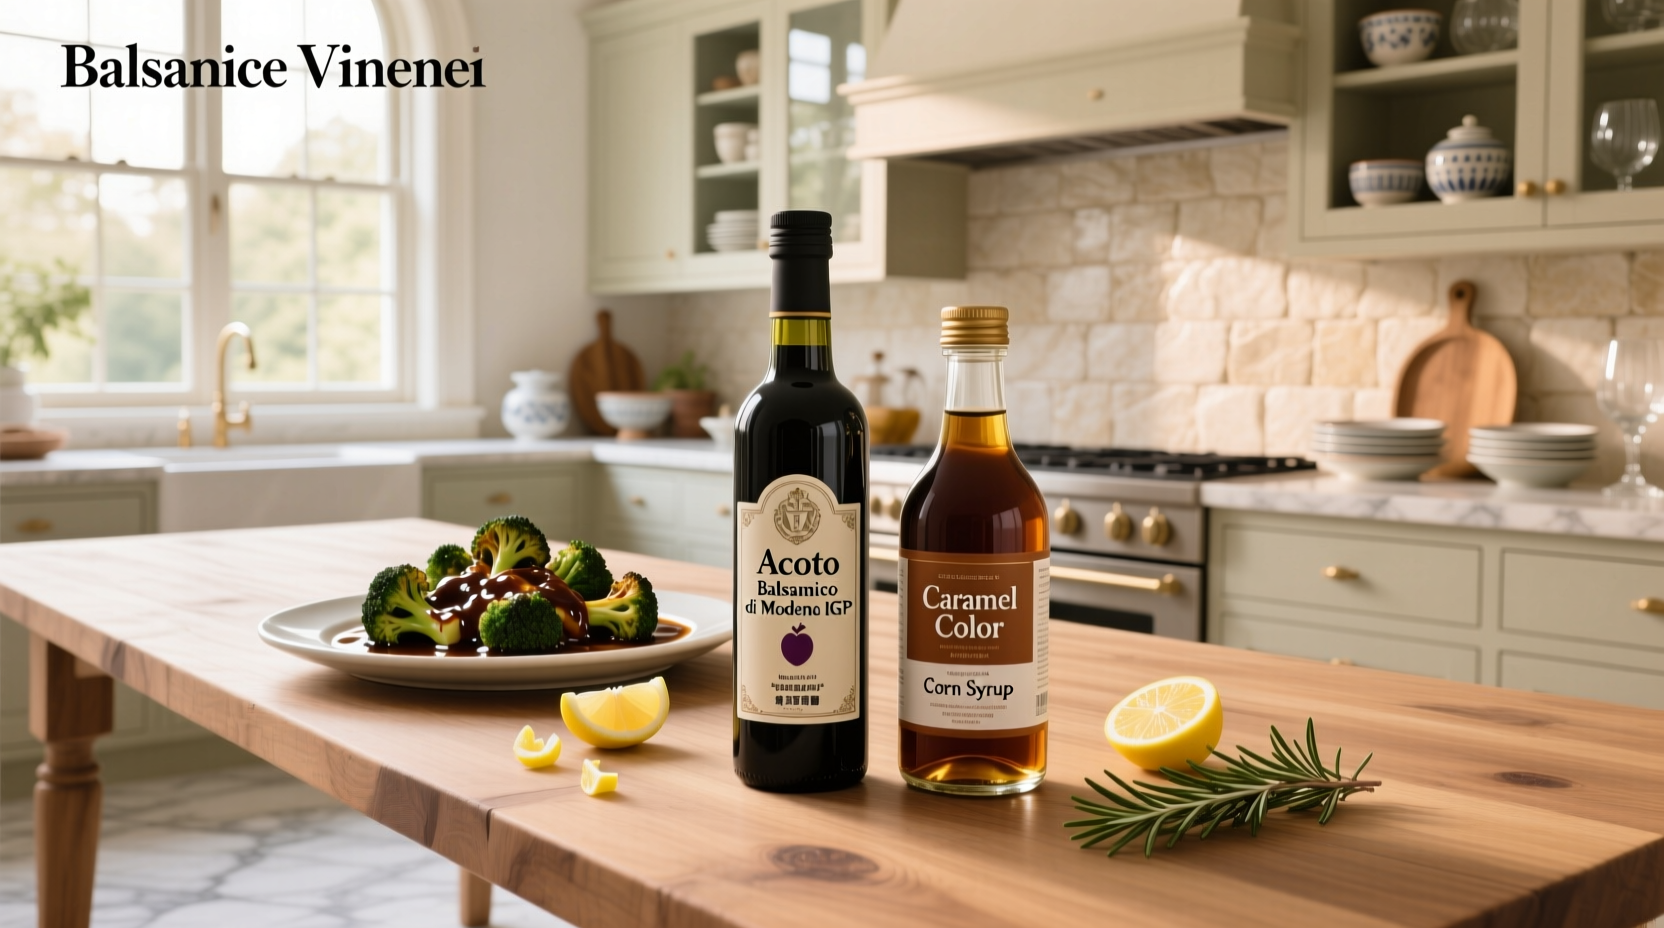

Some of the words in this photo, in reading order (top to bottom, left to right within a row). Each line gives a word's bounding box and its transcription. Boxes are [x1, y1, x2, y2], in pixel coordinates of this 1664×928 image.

[756, 548, 840, 576] Acoto
[757, 580, 839, 597] Balsamico
[922, 584, 1018, 610] Caramel
[745, 599, 757, 615] di
[825, 600, 853, 616] IGP
[935, 613, 1005, 639] Color
[923, 677, 961, 696] Corn
[966, 679, 1014, 701] Syrup
